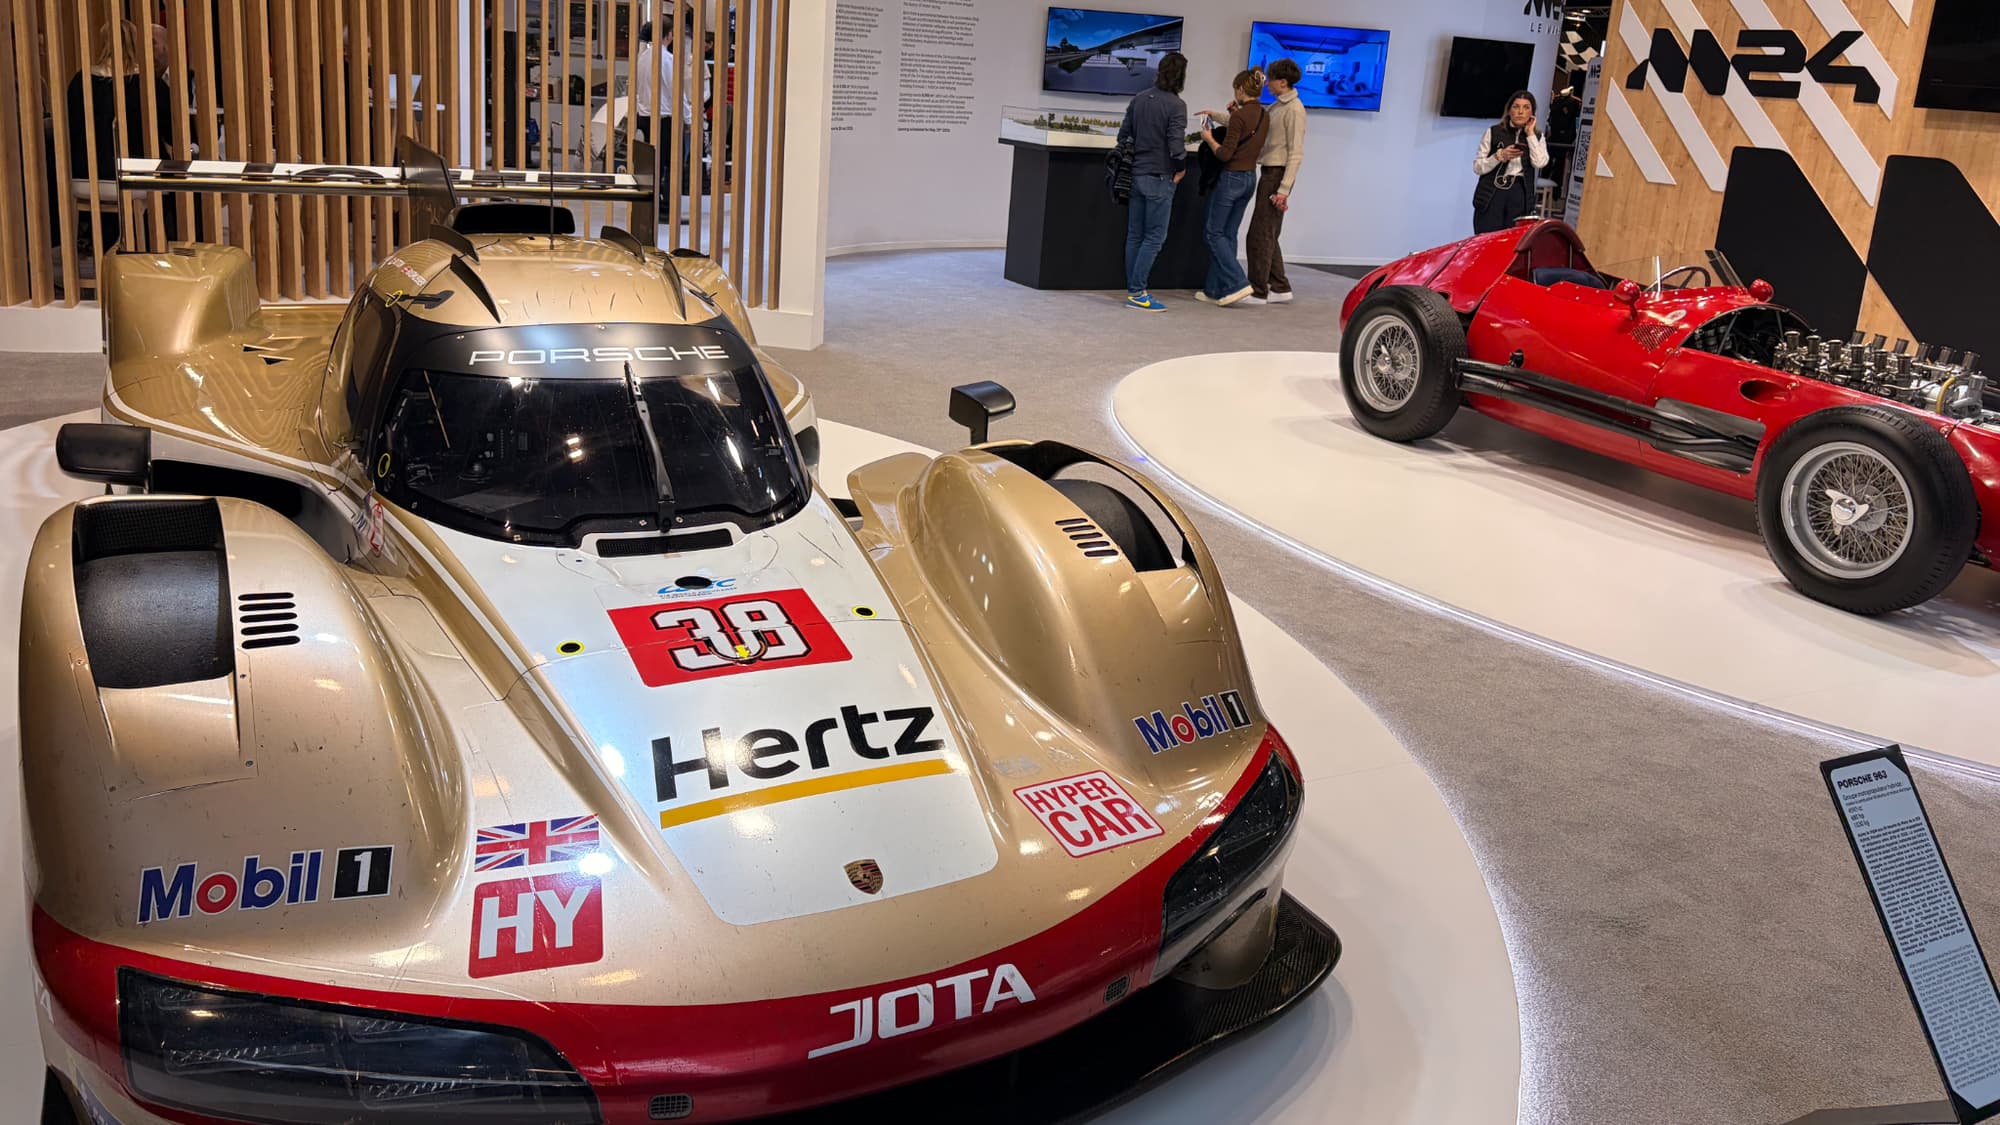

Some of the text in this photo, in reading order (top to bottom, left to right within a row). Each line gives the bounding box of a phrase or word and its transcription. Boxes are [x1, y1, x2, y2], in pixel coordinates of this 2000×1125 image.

[469, 346, 729, 365] PORSCHE
[650, 598, 813, 672] 38
[651, 704, 946, 802] Hertz
[1133, 694, 1229, 755] Mobil
[1024, 778, 1118, 814] HYPER
[1837, 770, 1888, 789] PORSCHE 963
[1048, 798, 1153, 848] CAR
[136, 849, 325, 925] Mobil
[479, 885, 593, 960] HY
[807, 963, 1037, 1060] JOTA
